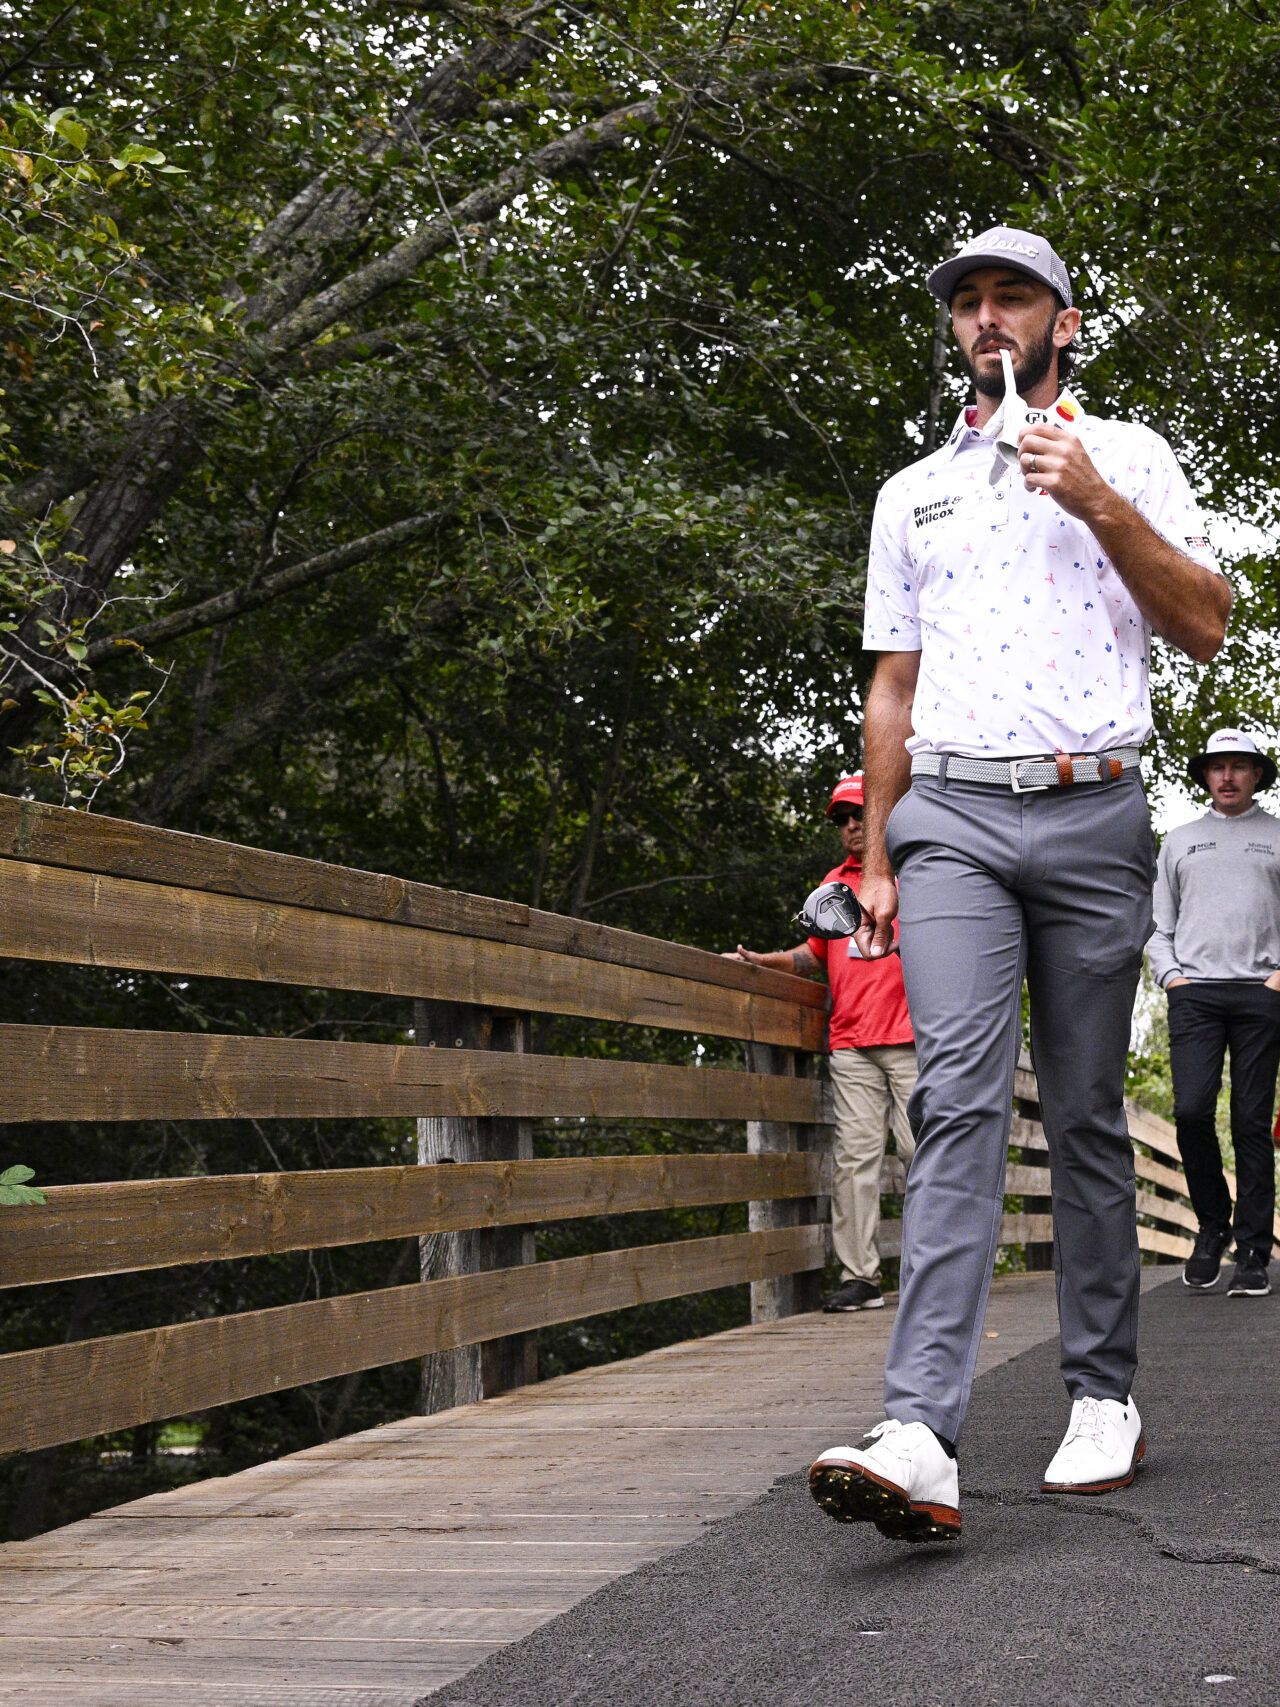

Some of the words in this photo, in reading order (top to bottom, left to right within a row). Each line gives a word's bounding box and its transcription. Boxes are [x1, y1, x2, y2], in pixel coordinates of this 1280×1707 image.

[914, 499, 949, 518] Burns
[951, 496, 963, 504] &
[915, 508, 953, 528] Wilcox
